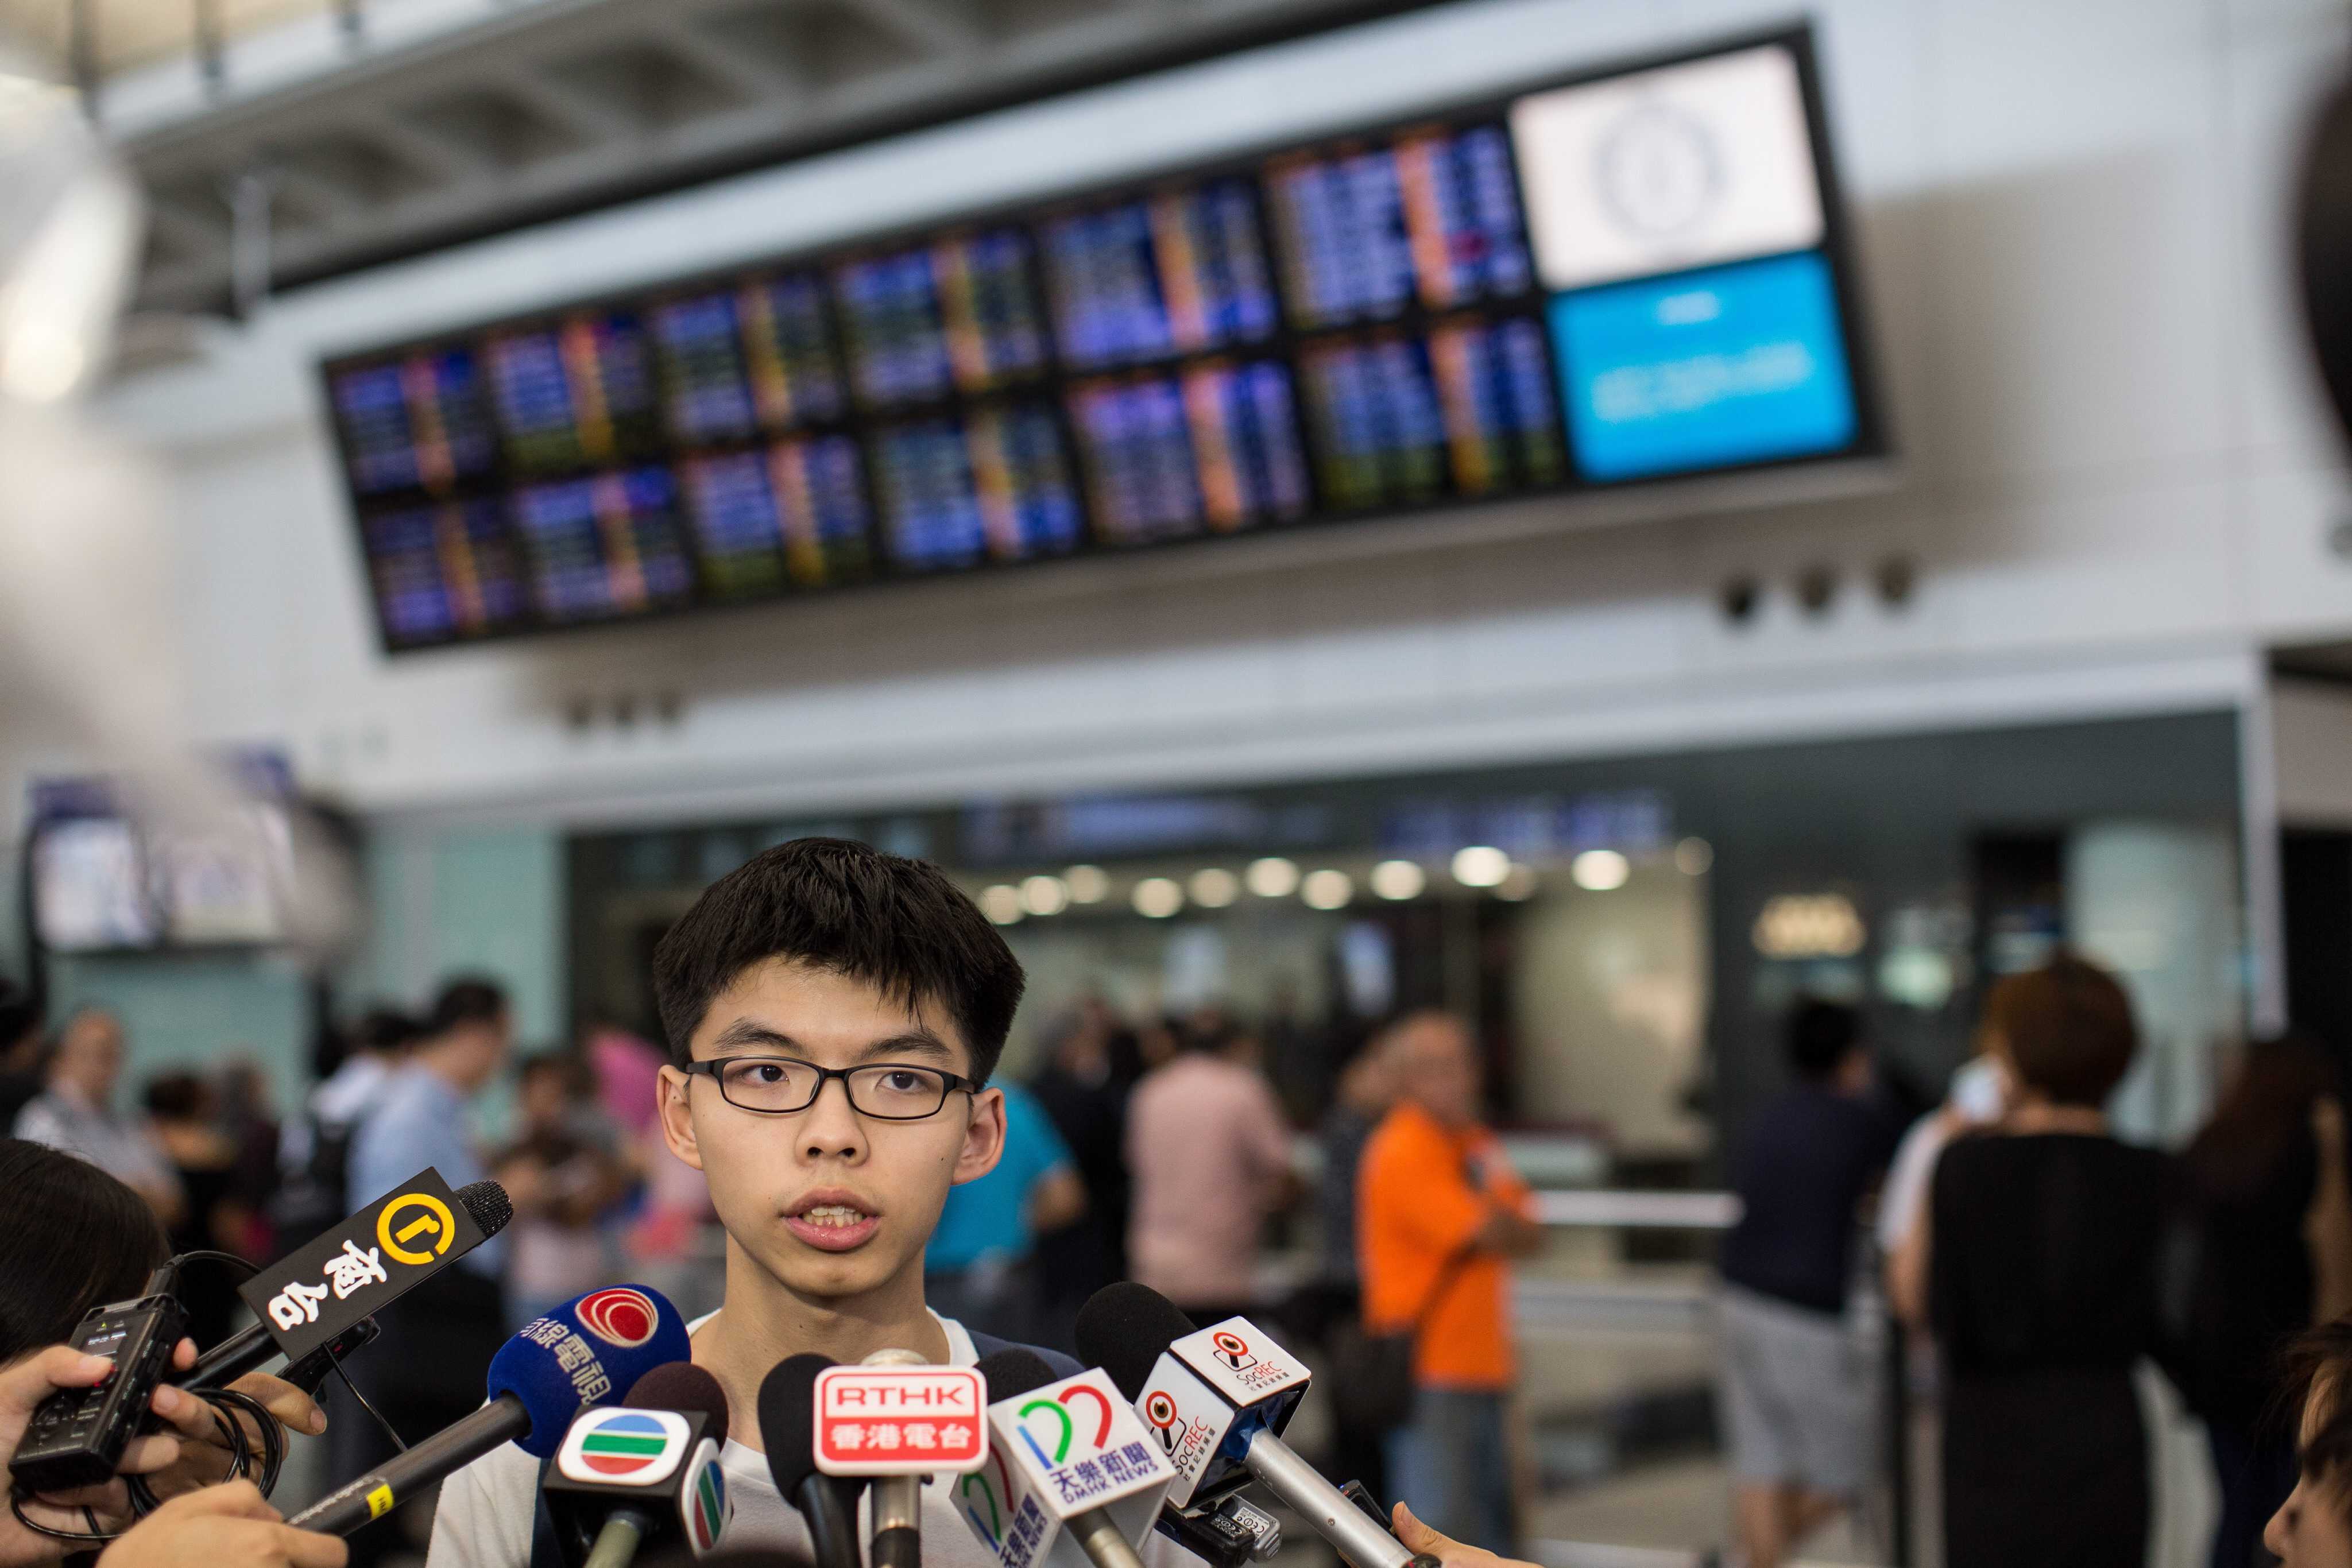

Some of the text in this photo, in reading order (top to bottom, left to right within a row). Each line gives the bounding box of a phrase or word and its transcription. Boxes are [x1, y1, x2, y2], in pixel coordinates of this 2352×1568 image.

[268, 1240, 387, 1331] 商台
[837, 1387, 964, 1406] RTHK
[830, 1423, 973, 1450] 香港電台
[1113, 1459, 1158, 1485] NEWS
